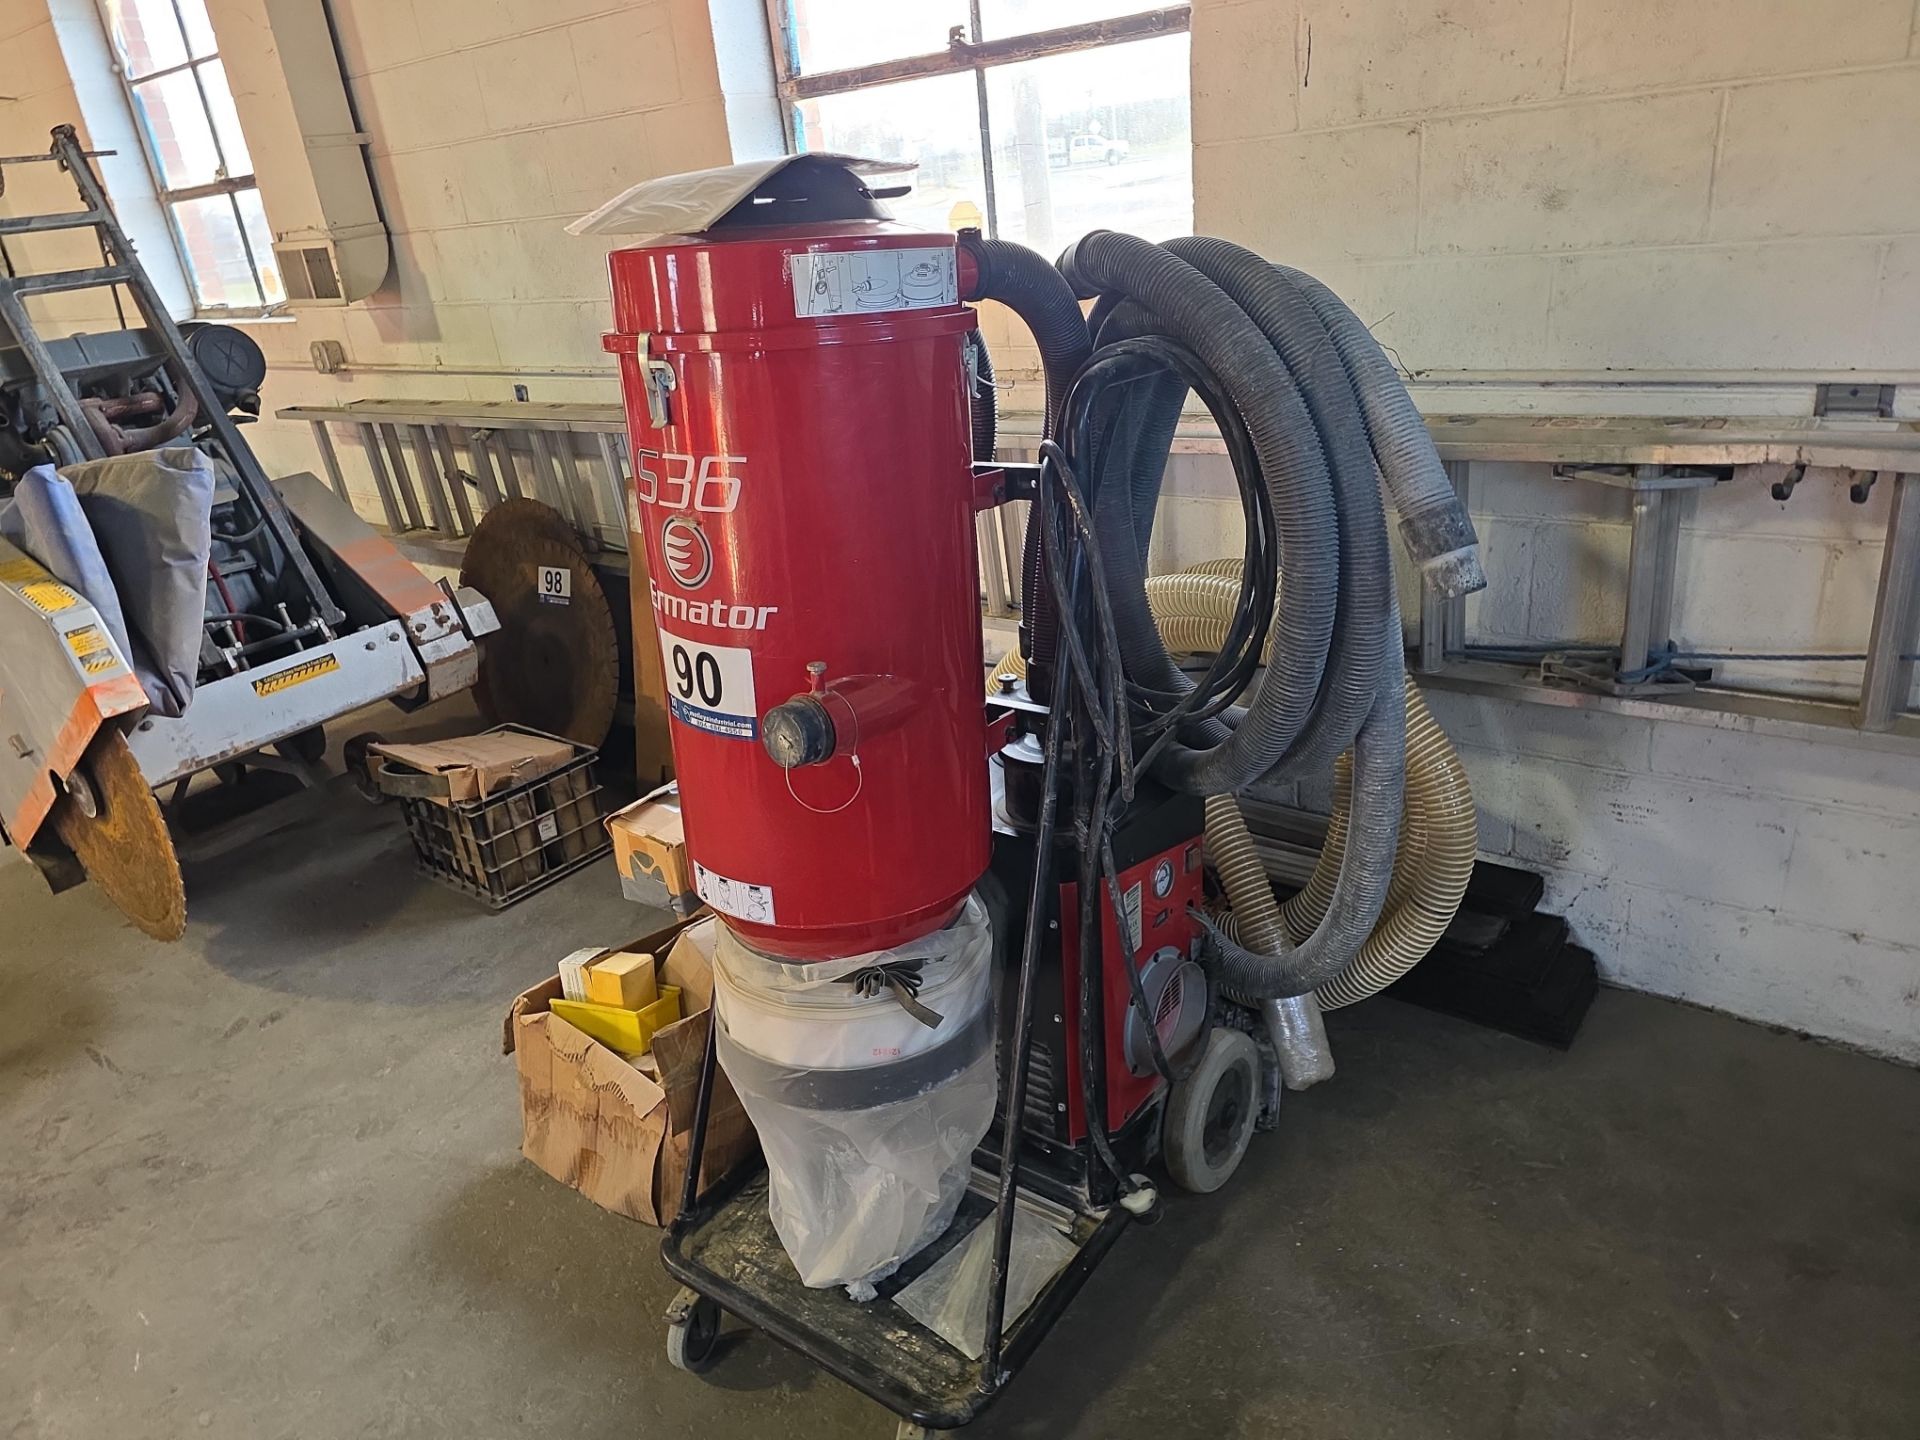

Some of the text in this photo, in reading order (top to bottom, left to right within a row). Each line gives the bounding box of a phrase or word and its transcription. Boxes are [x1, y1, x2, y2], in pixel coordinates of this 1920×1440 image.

[638, 448, 748, 513] S36
[544, 570, 563, 594] 98
[672, 643, 723, 708] 90
